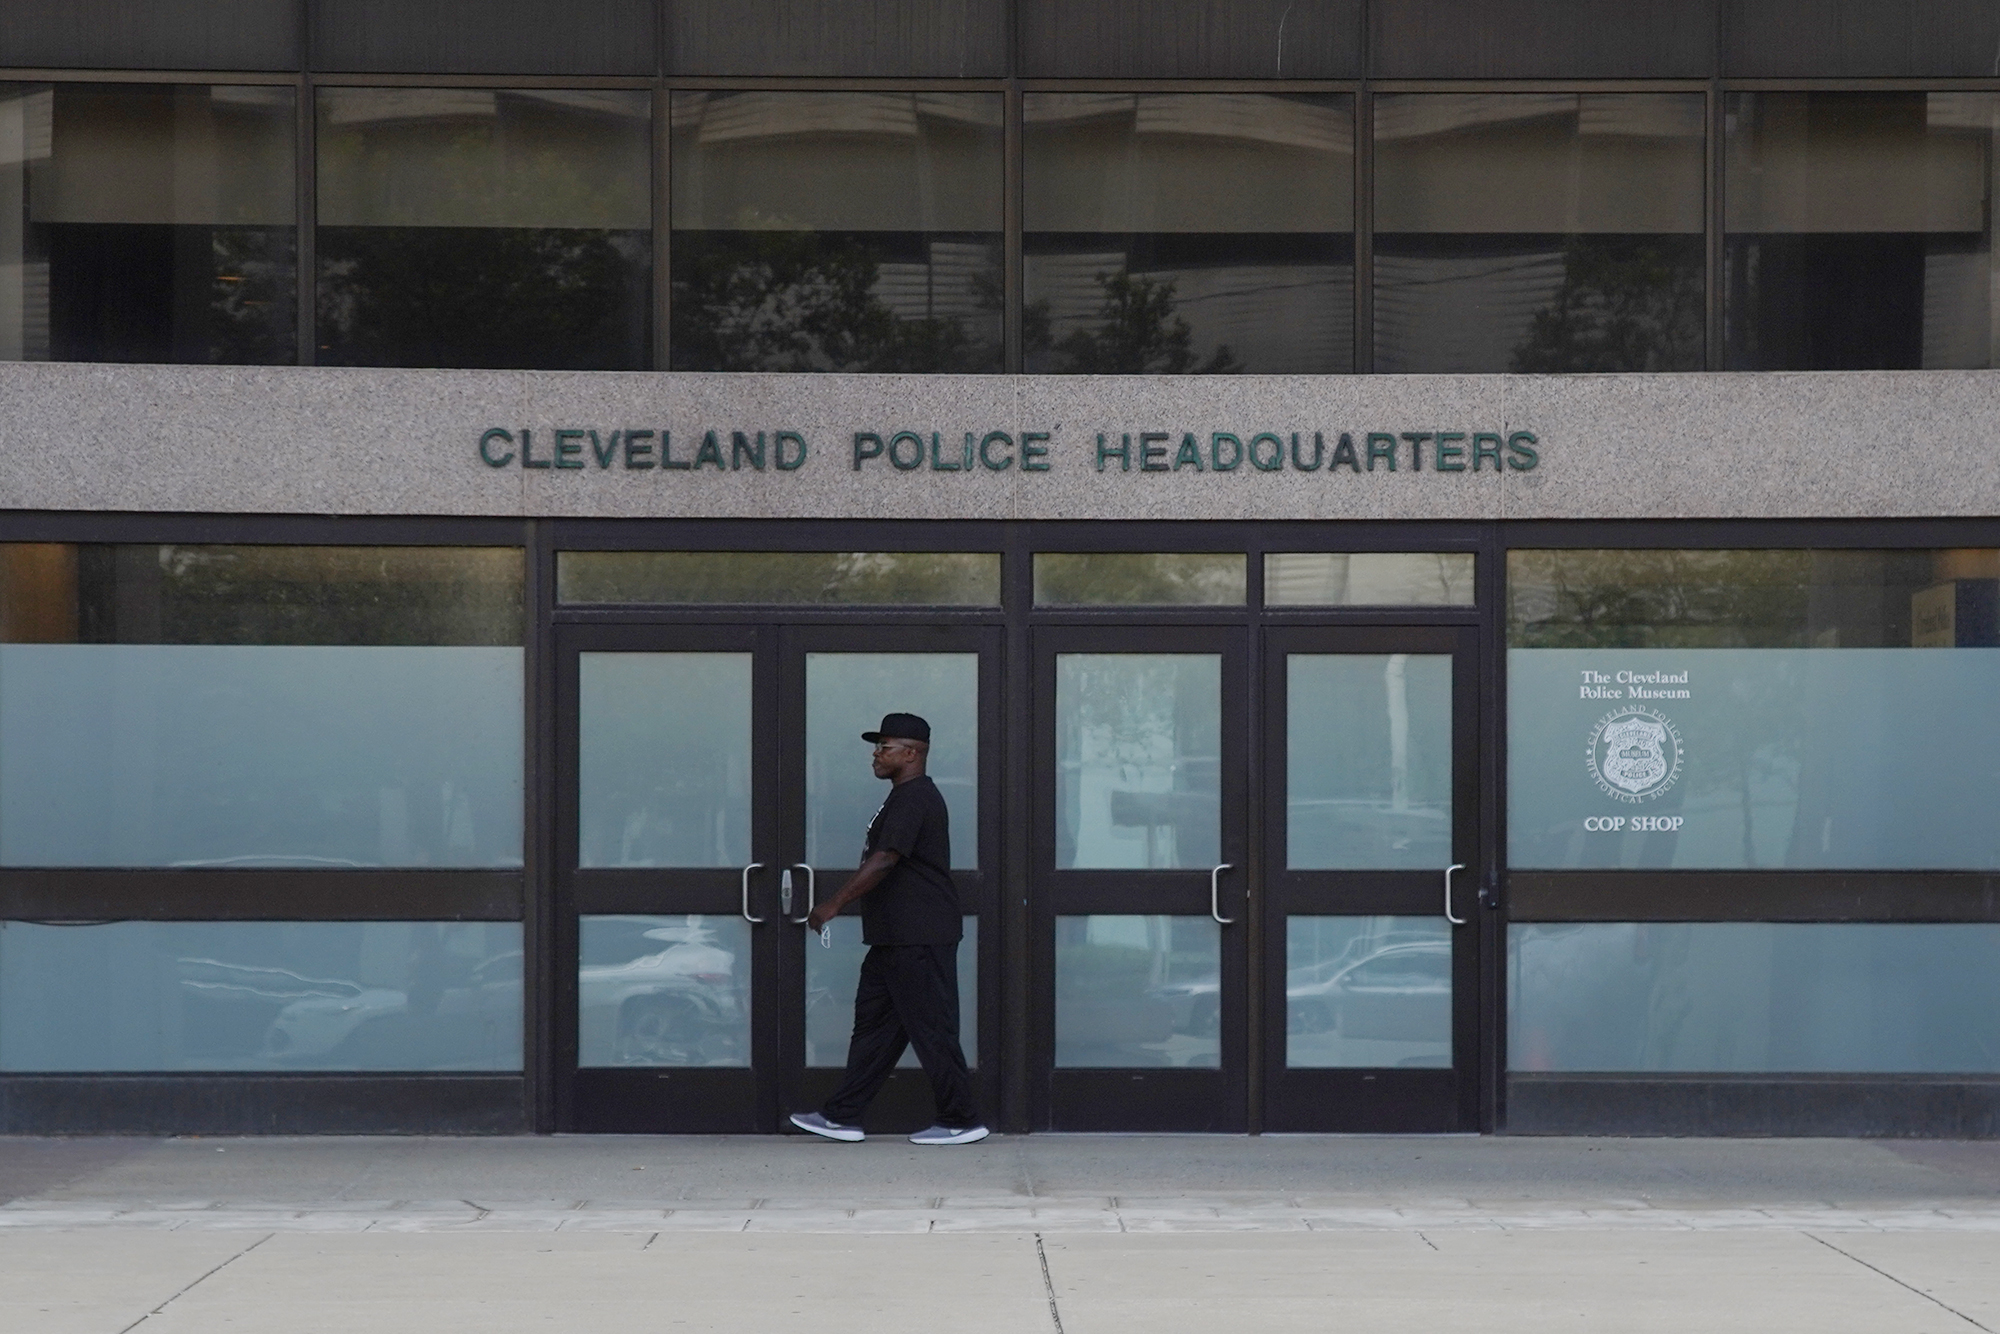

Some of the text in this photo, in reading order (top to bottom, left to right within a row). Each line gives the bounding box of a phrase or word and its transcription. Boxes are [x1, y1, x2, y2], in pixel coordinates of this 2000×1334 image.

[479, 428, 1539, 473] CLEVELAND POLICE HEADQUARTERS
[1581, 670, 1689, 684] The Cleveland
[1580, 686, 1691, 699] Police Museum
[1587, 704, 1685, 746] CLEVELAND POLICE
[1586, 758, 1685, 804] HISTORICAL SOCIETY
[1584, 816, 1685, 832] COP SHOP
